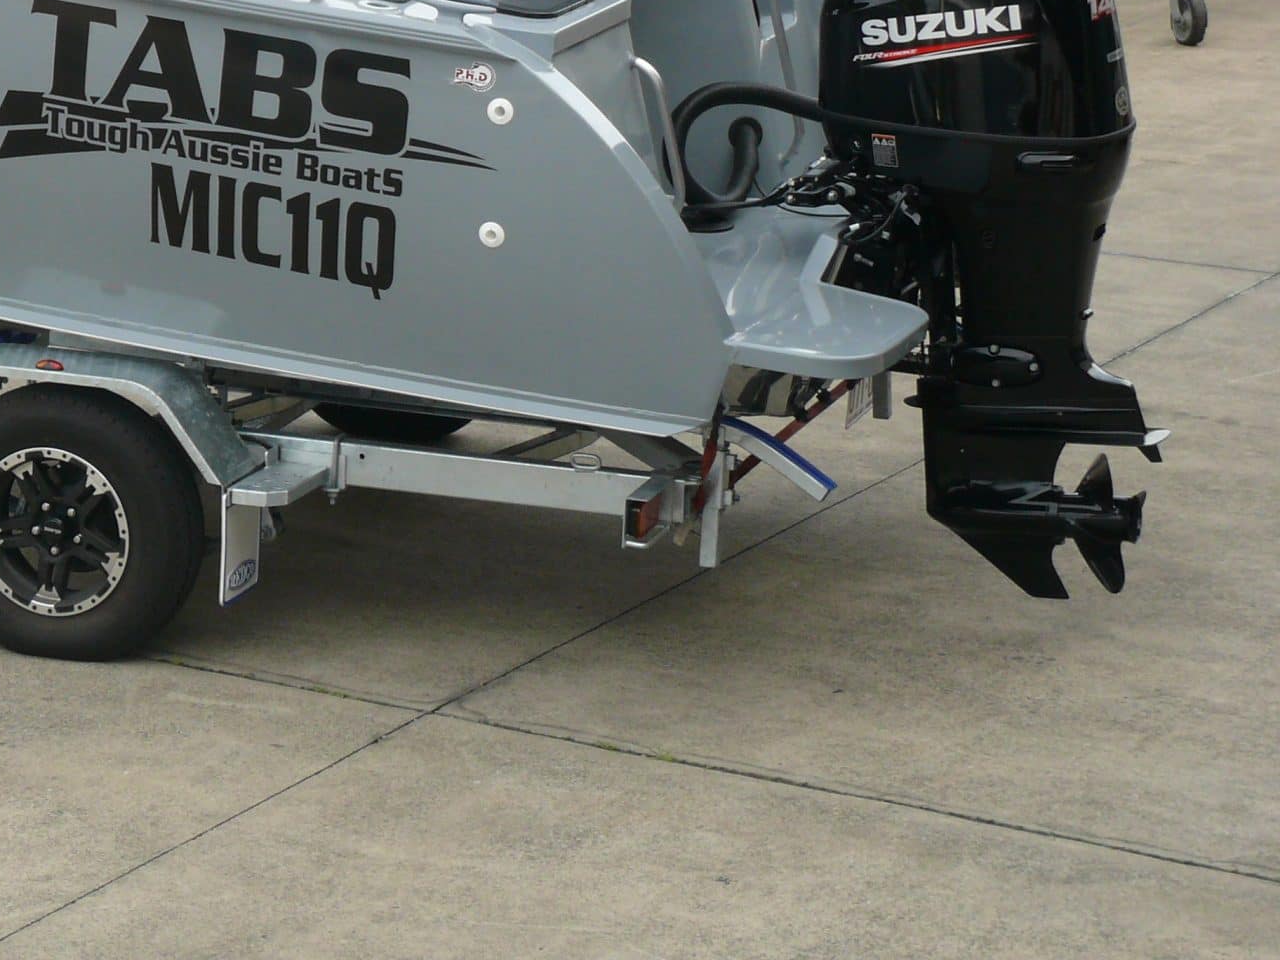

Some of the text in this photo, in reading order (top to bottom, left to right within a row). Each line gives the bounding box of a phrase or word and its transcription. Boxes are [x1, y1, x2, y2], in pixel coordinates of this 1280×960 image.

[861, 4, 1022, 46] SUZUKI
[48, 106, 150, 152] Tough
[162, 130, 282, 176] Aussie
[150, 162, 396, 300] MIC11Q
